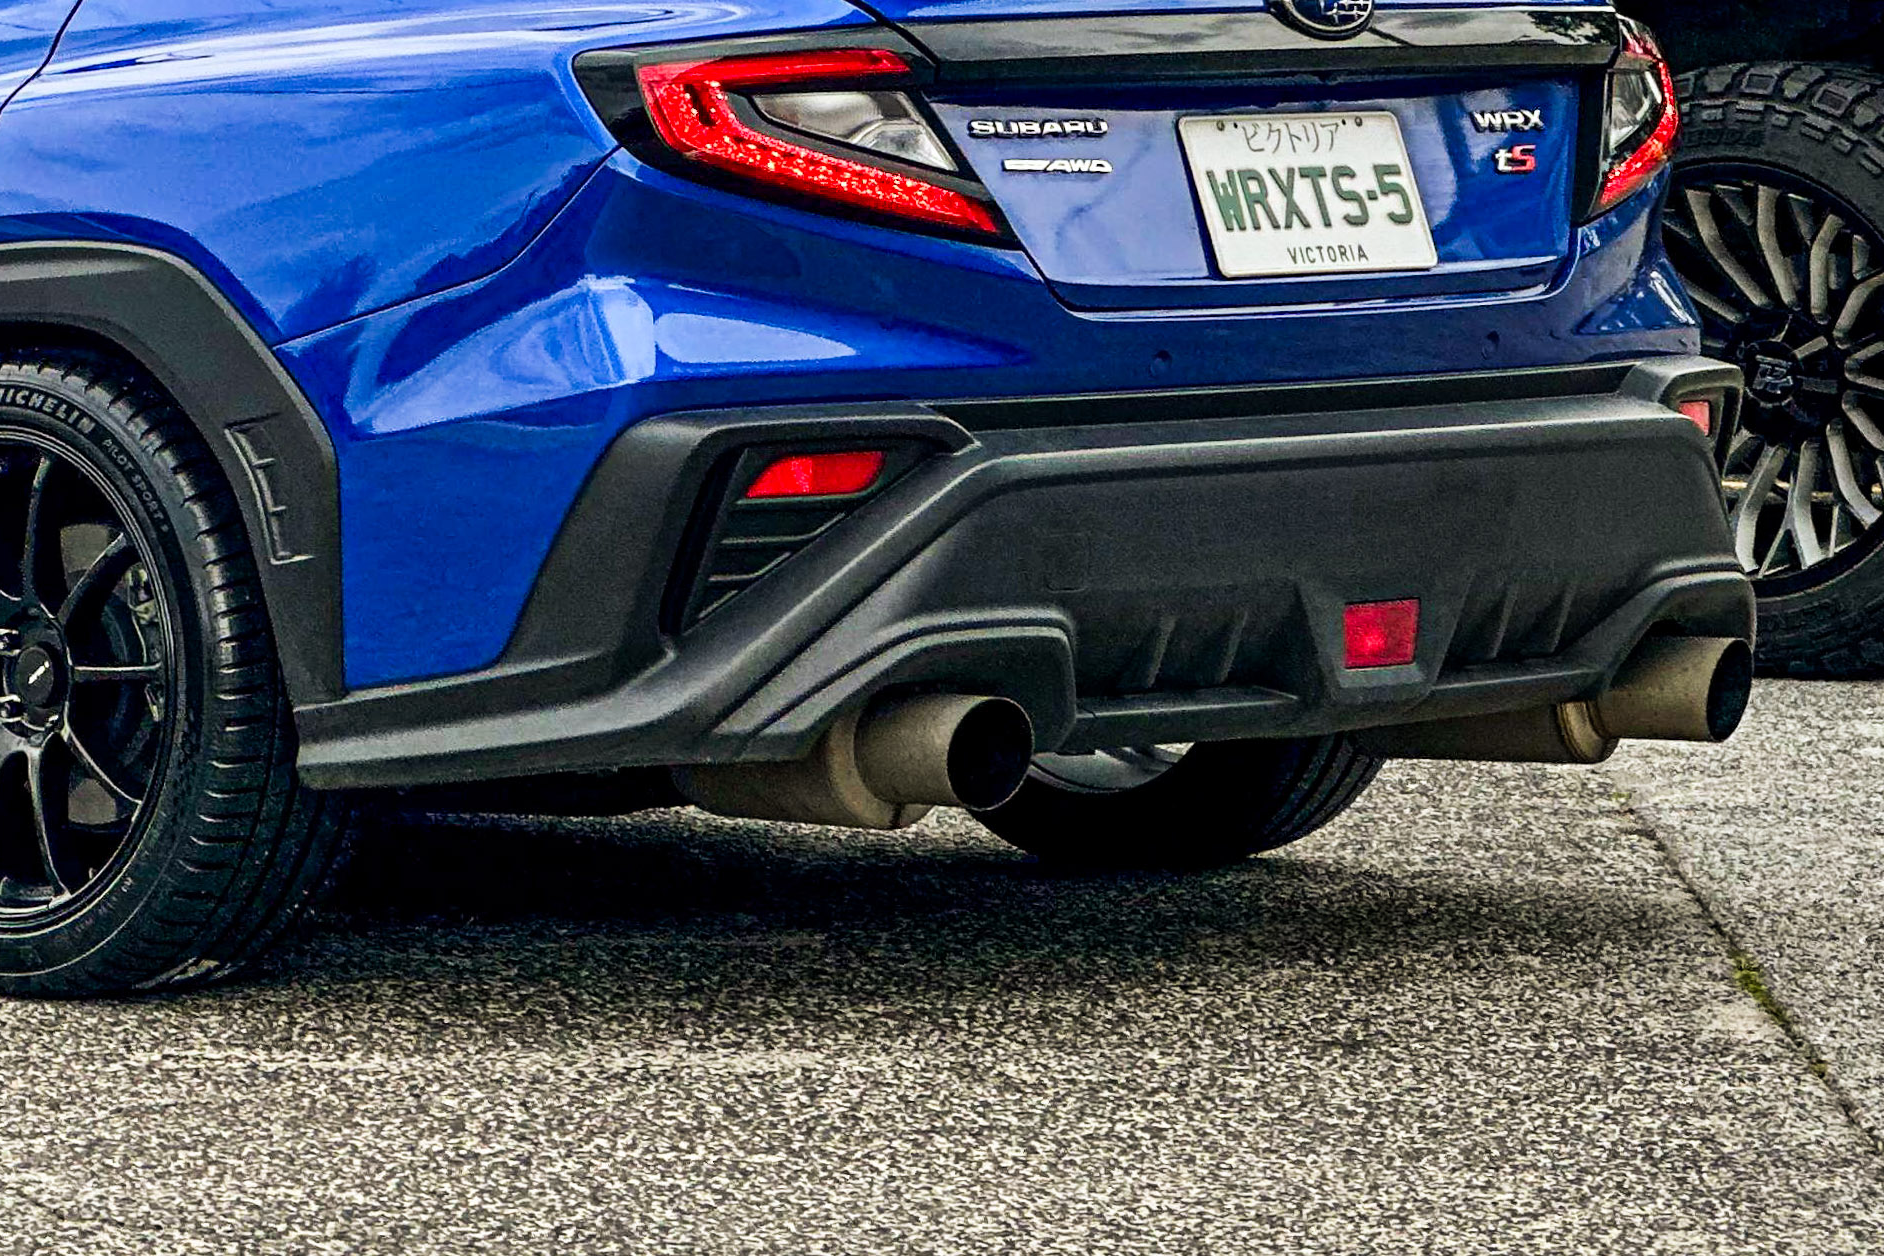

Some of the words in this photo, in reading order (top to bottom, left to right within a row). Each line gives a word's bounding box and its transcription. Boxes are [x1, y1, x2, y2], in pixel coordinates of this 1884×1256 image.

[970, 119, 1109, 136] SUBARU
[1472, 109, 1545, 132] WRX
[1242, 120, 1341, 154] ビクトリア
[1046, 159, 1114, 173] AWD
[1495, 144, 1537, 174] tS
[1208, 163, 1414, 232] WRXTS-5
[1287, 243, 1370, 265] VICTORIA
